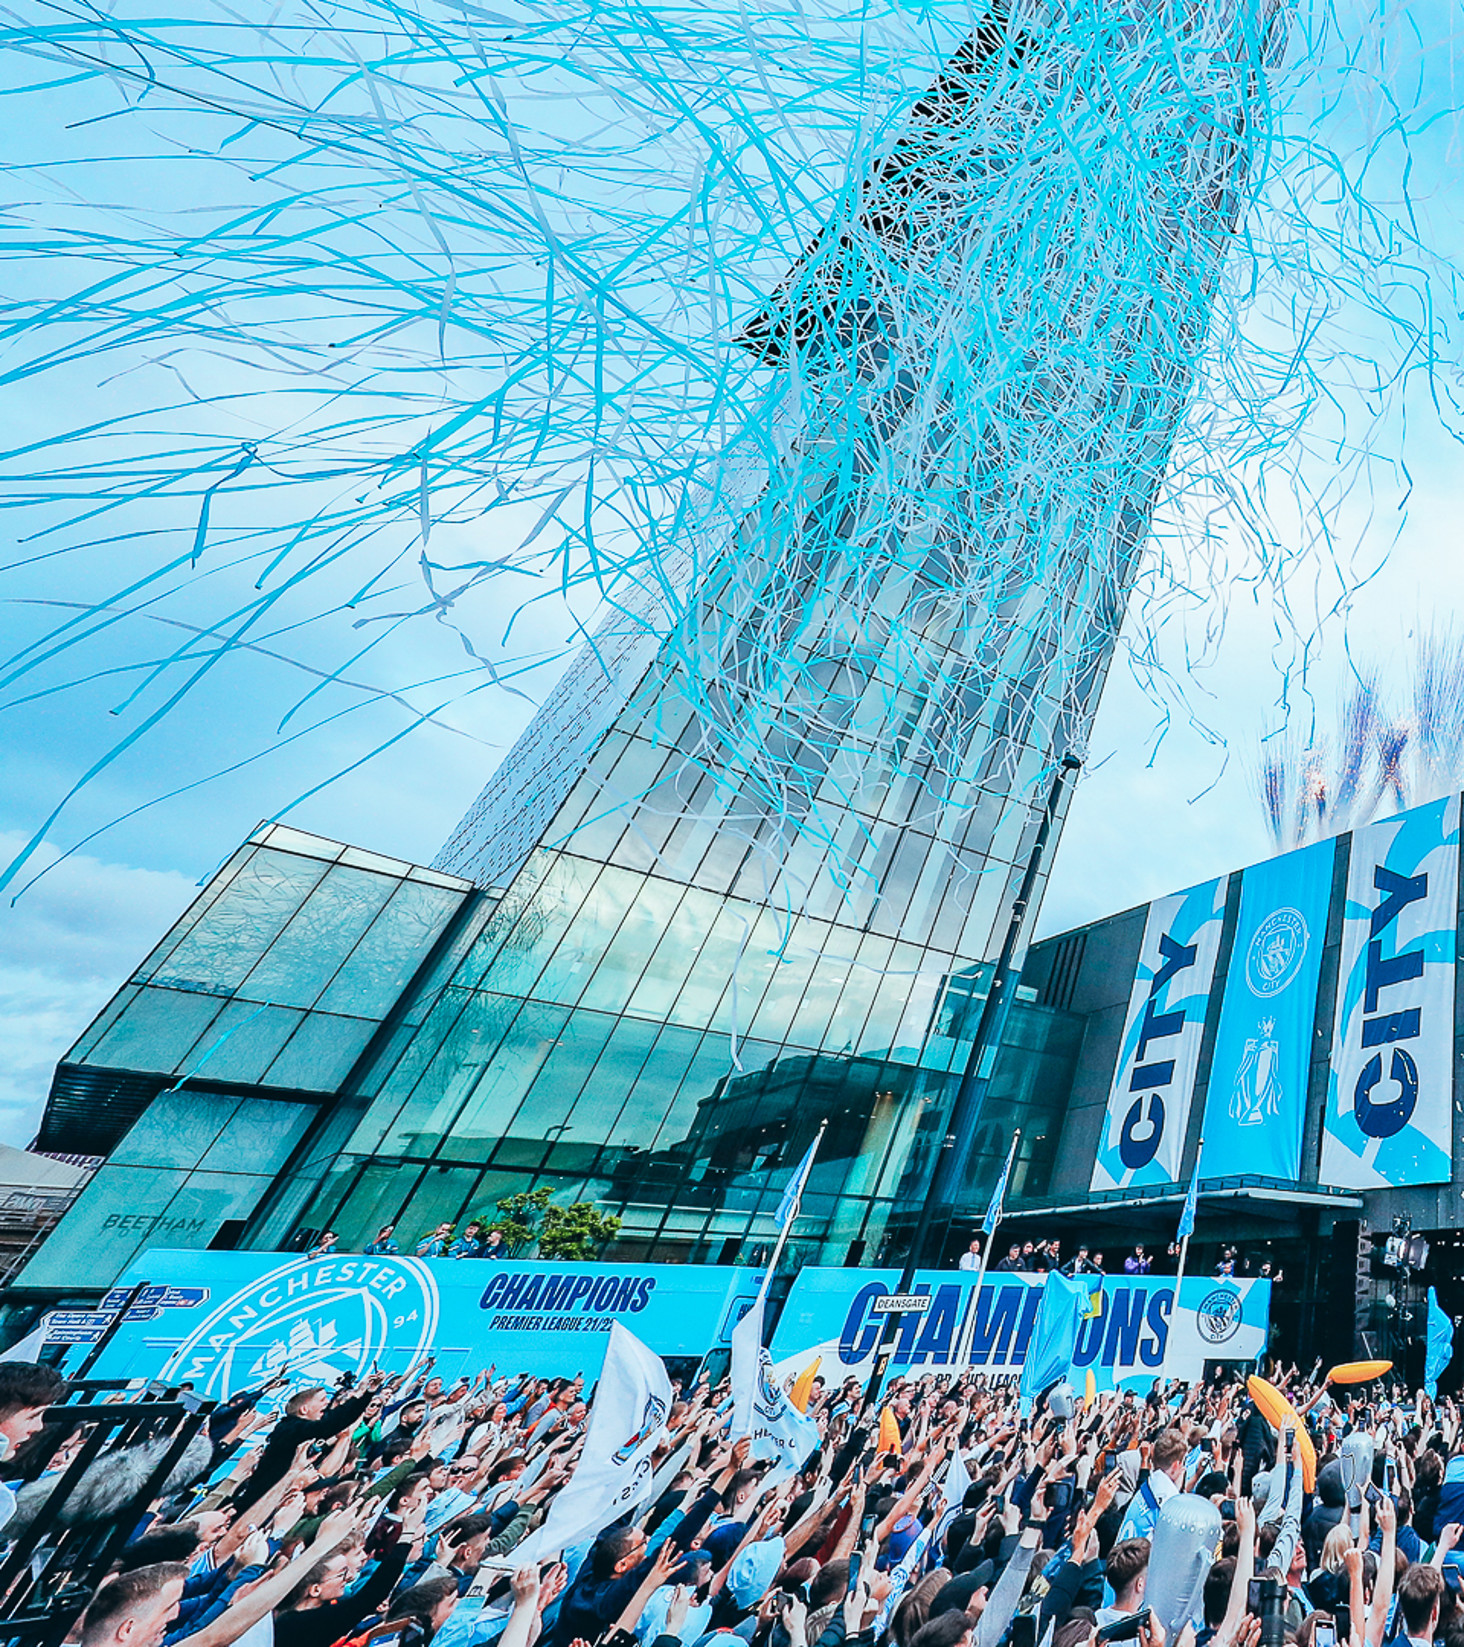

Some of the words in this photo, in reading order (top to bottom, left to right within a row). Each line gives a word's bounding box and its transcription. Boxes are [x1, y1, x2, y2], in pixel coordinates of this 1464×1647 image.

[1354, 865, 1428, 1139] CITY
[1118, 932, 1198, 1169] CITY
[102, 1214, 206, 1232] BEETHAM
[479, 1273, 656, 1313] CHAMPIONS
[877, 1298, 927, 1309] DEANSGATE
[181, 1262, 406, 1379] MANCHESTER
[393, 1309, 418, 1329] 94
[489, 1315, 542, 1331] PREMIER
[542, 1316, 585, 1331] LEAGUE
[839, 1282, 1175, 1367] CHAMONS
